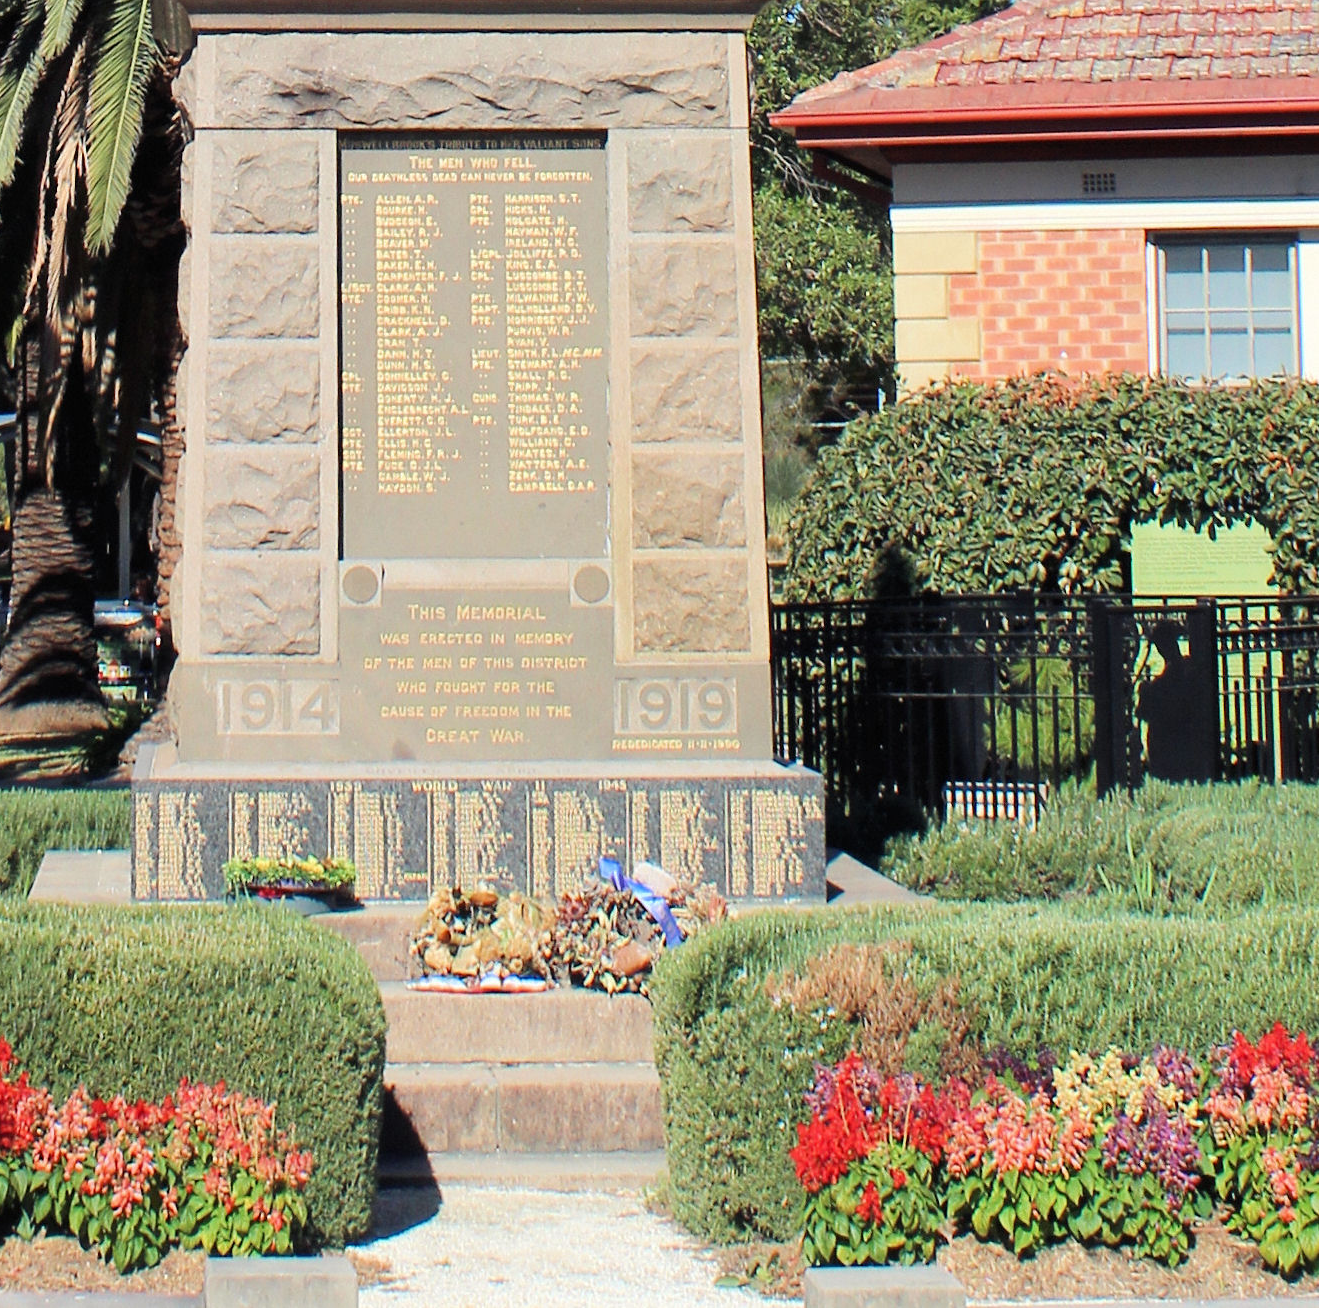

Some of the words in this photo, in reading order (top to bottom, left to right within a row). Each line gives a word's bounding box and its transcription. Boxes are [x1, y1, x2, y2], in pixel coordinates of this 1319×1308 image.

[486, 140, 497, 150] TO
[524, 140, 569, 150] VALIANT
[409, 156, 433, 169] THE
[439, 156, 463, 169] MEN
[470, 156, 499, 169] WHO
[505, 156, 536, 169] FELL.
[348, 172, 368, 182] OUR
[433, 172, 457, 182] DEAD
[461, 172, 482, 182] CAN
[486, 172, 515, 182] NEVER
[519, 172, 531, 182] BE
[408, 605, 446, 620] THIS
[457, 605, 547, 620] MEMORIAL
[380, 633, 410, 645] WAS
[420, 633, 483, 645] ERECTED
[491, 633, 505, 645] IN
[515, 633, 574, 645] MEMORY
[364, 658, 382, 669] OF
[387, 658, 414, 669] THE
[423, 658, 452, 669] MEN
[460, 658, 477, 669] OF
[484, 658, 513, 669] THIS
[521, 658, 587, 669] DISTRICT
[396, 682, 427, 695] WHO
[435, 682, 487, 695] FOUGHT
[494, 682, 521, 695] FOR
[527, 682, 555, 695] THE
[222, 683, 334, 730] 1914
[620, 682, 730, 729] 1919
[380, 706, 424, 718] CAUSE
[431, 706, 447, 718] OF
[456, 706, 520, 718] FREEDOM
[526, 706, 540, 718] IN
[546, 706, 572, 718] THE
[426, 728, 480, 744] GREAT
[412, 781, 459, 792] WORLD
[481, 781, 512, 792] WAR
[598, 781, 627, 792] 1945
